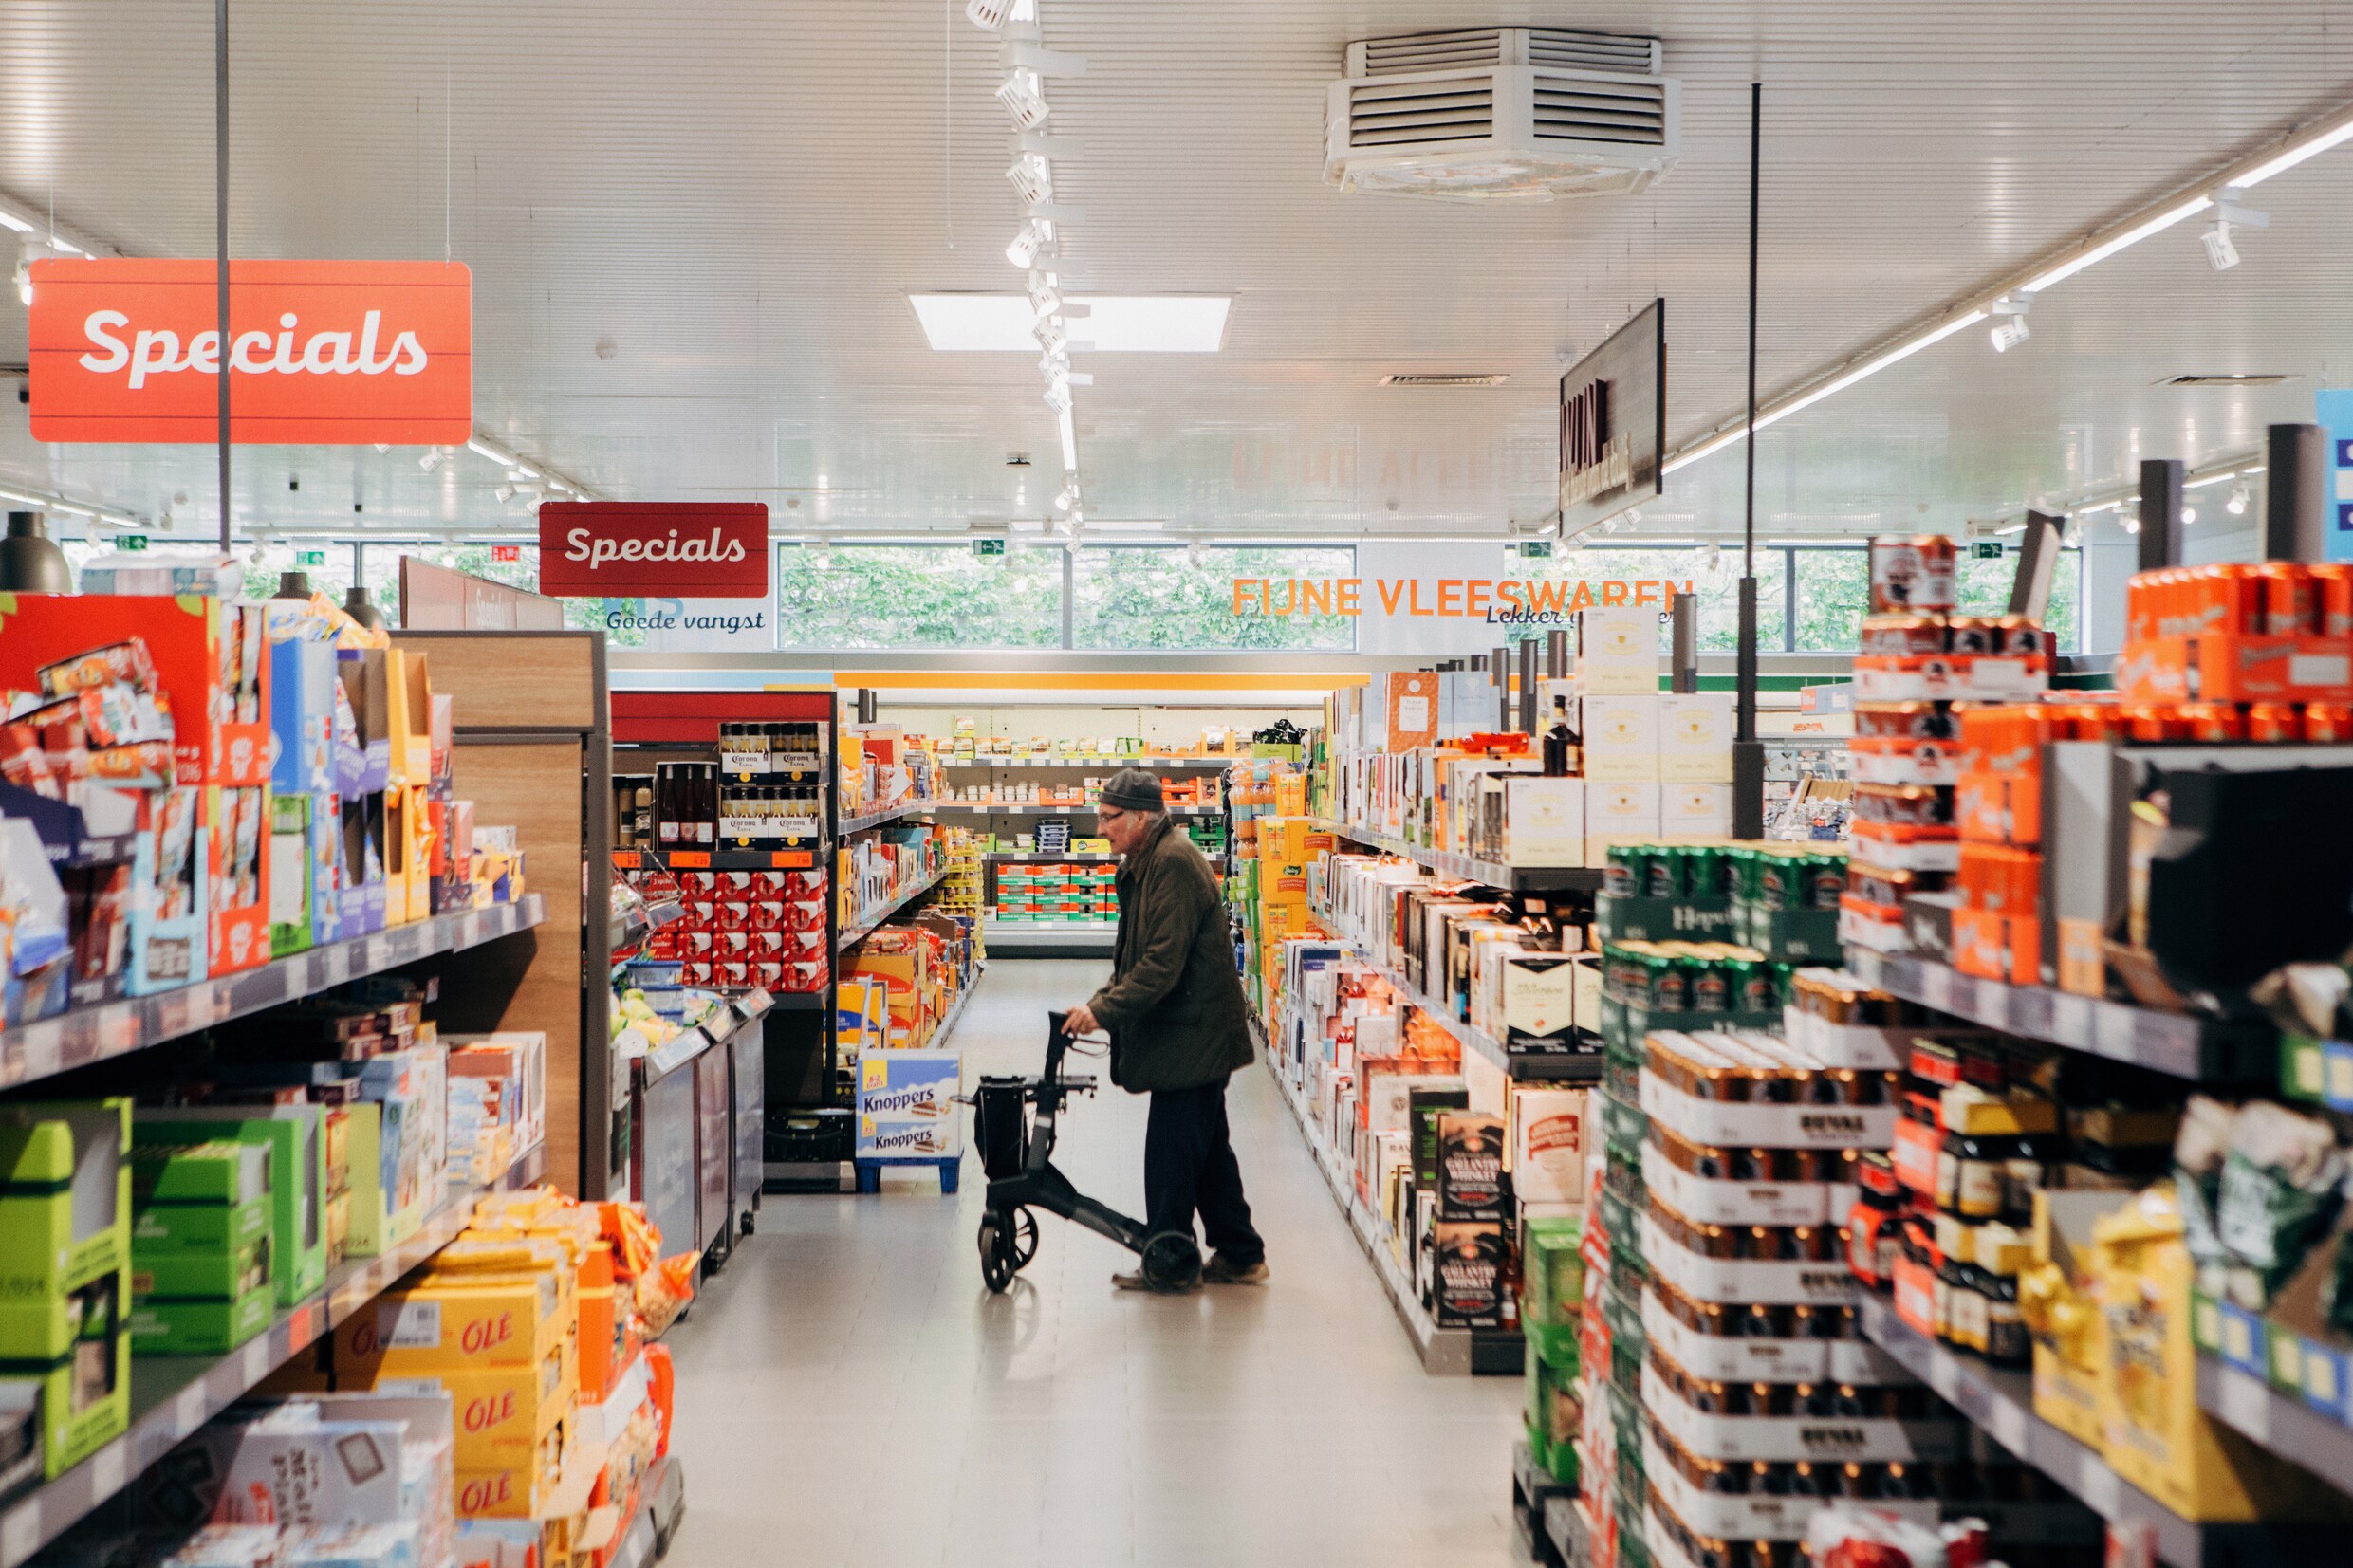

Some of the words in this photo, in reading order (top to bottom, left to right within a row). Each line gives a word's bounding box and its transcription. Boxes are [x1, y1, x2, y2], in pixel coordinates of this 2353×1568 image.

[78, 309, 428, 389] Specials
[565, 527, 747, 569] Specials
[1232, 578, 1362, 616] FIJNE
[1376, 578, 1694, 617] VLEESWAREN
[606, 610, 676, 630] Goede
[684, 612, 766, 634] vangst
[1486, 605, 1563, 625] Lekker
[732, 755, 758, 764] Corona
[783, 754, 809, 764] Corona
[730, 819, 756, 828] Corona
[779, 819, 806, 828] Corona
[863, 1088, 934, 1114] Knoppers
[875, 1129, 932, 1150] Knoppers
[461, 1312, 513, 1355] OLÉ
[464, 1388, 516, 1433] OLÉ
[460, 1470, 513, 1515] OLÉ
